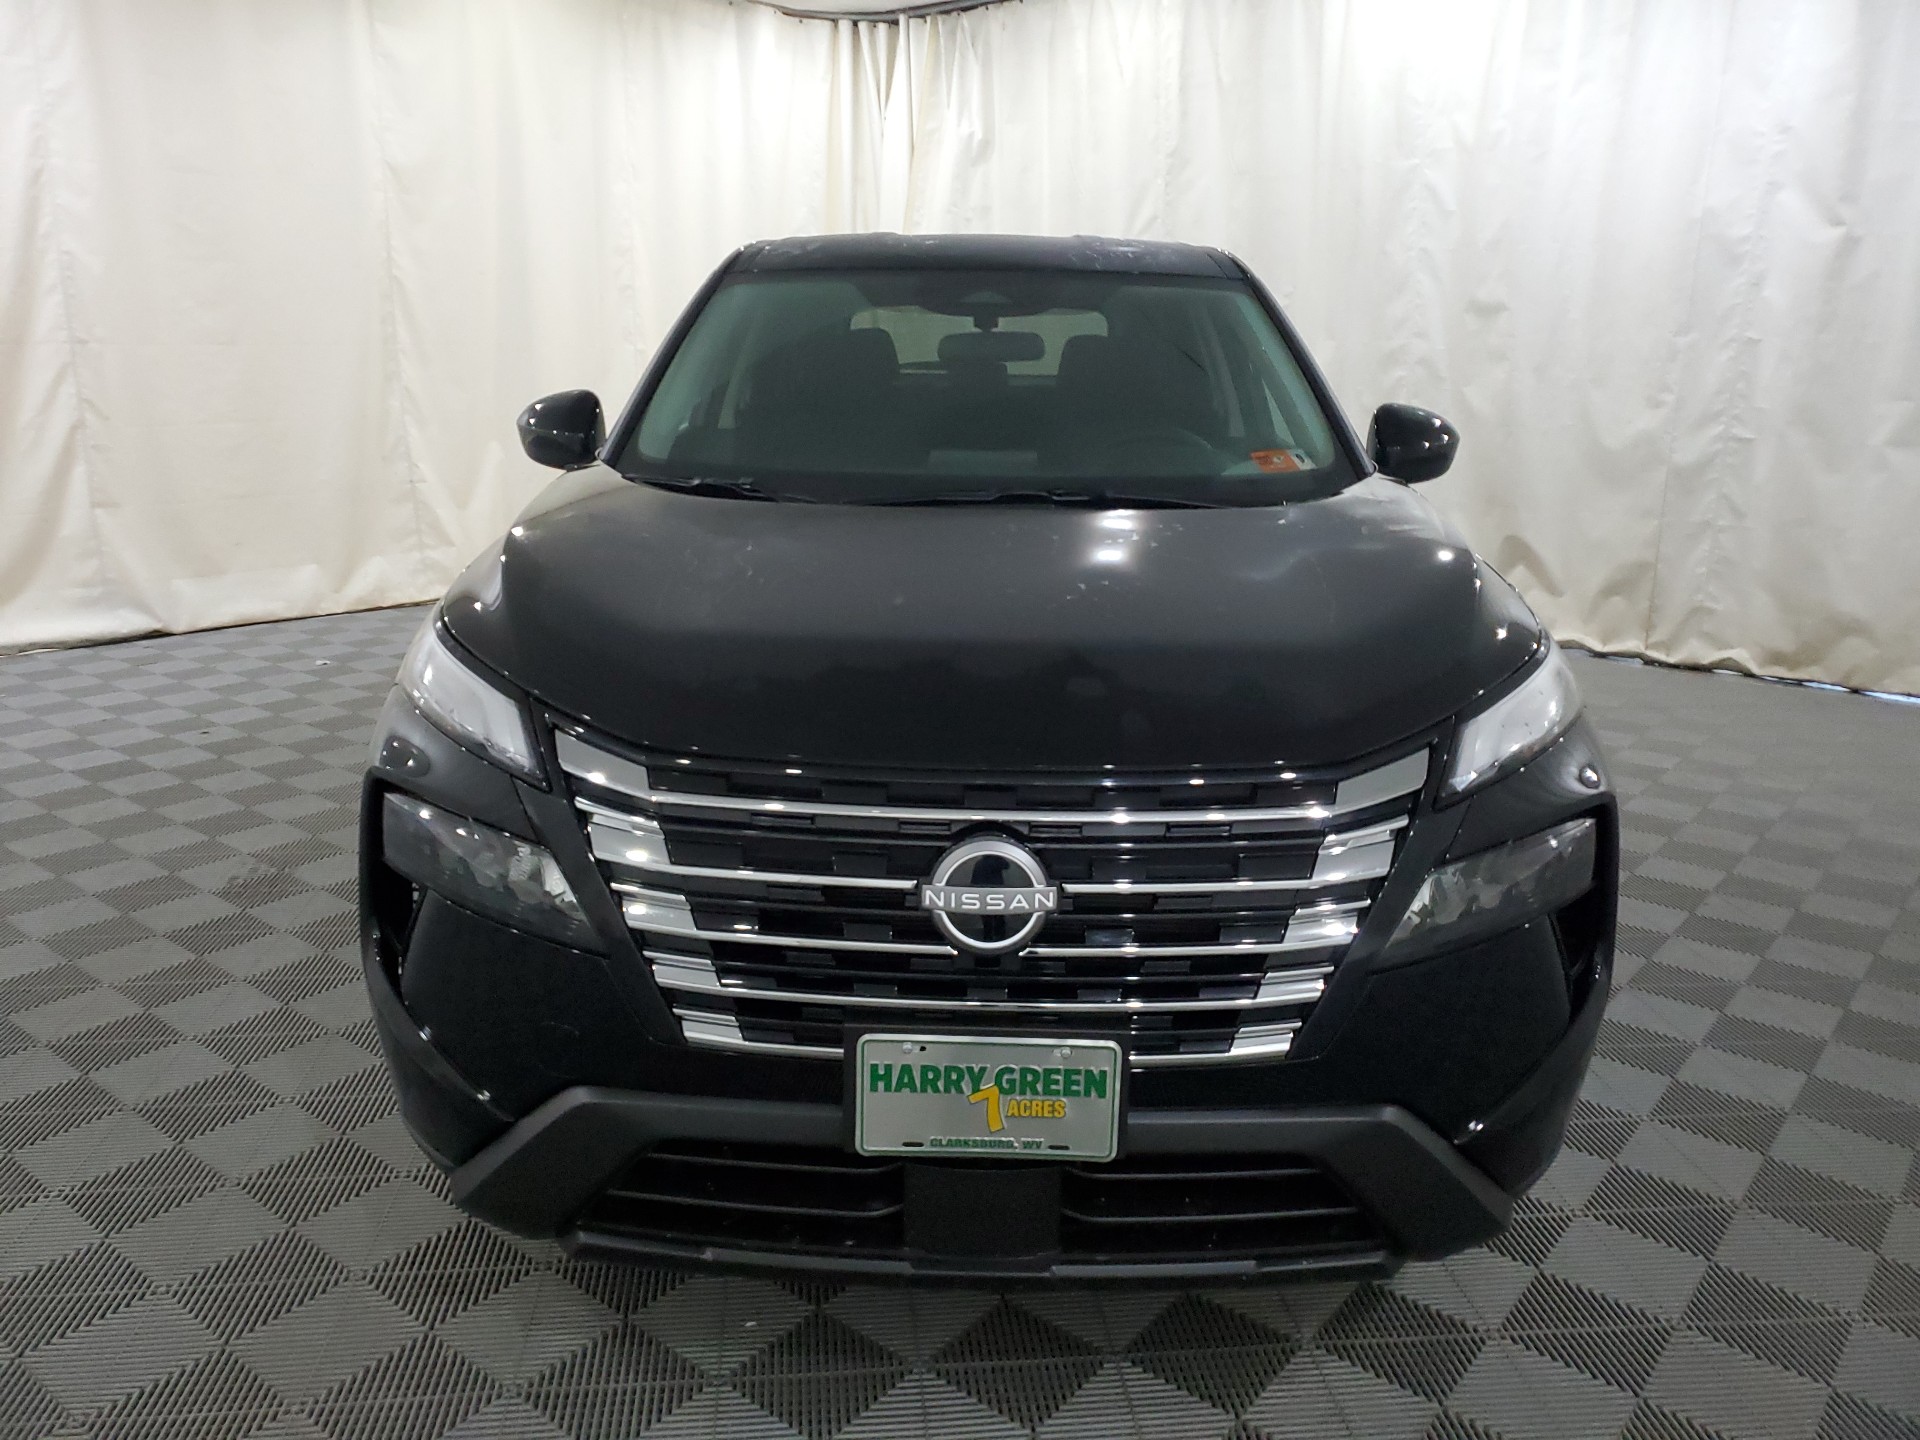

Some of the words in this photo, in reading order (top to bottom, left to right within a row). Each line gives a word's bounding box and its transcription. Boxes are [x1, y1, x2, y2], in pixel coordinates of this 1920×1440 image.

[924, 889, 1054, 910] NISSAN
[869, 1062, 988, 1094] HARRY
[994, 1065, 1108, 1099] GREEN
[967, 1083, 1004, 1132] 7
[1006, 1099, 1066, 1119] ACRES
[1022, 1138, 1043, 1150] WV
